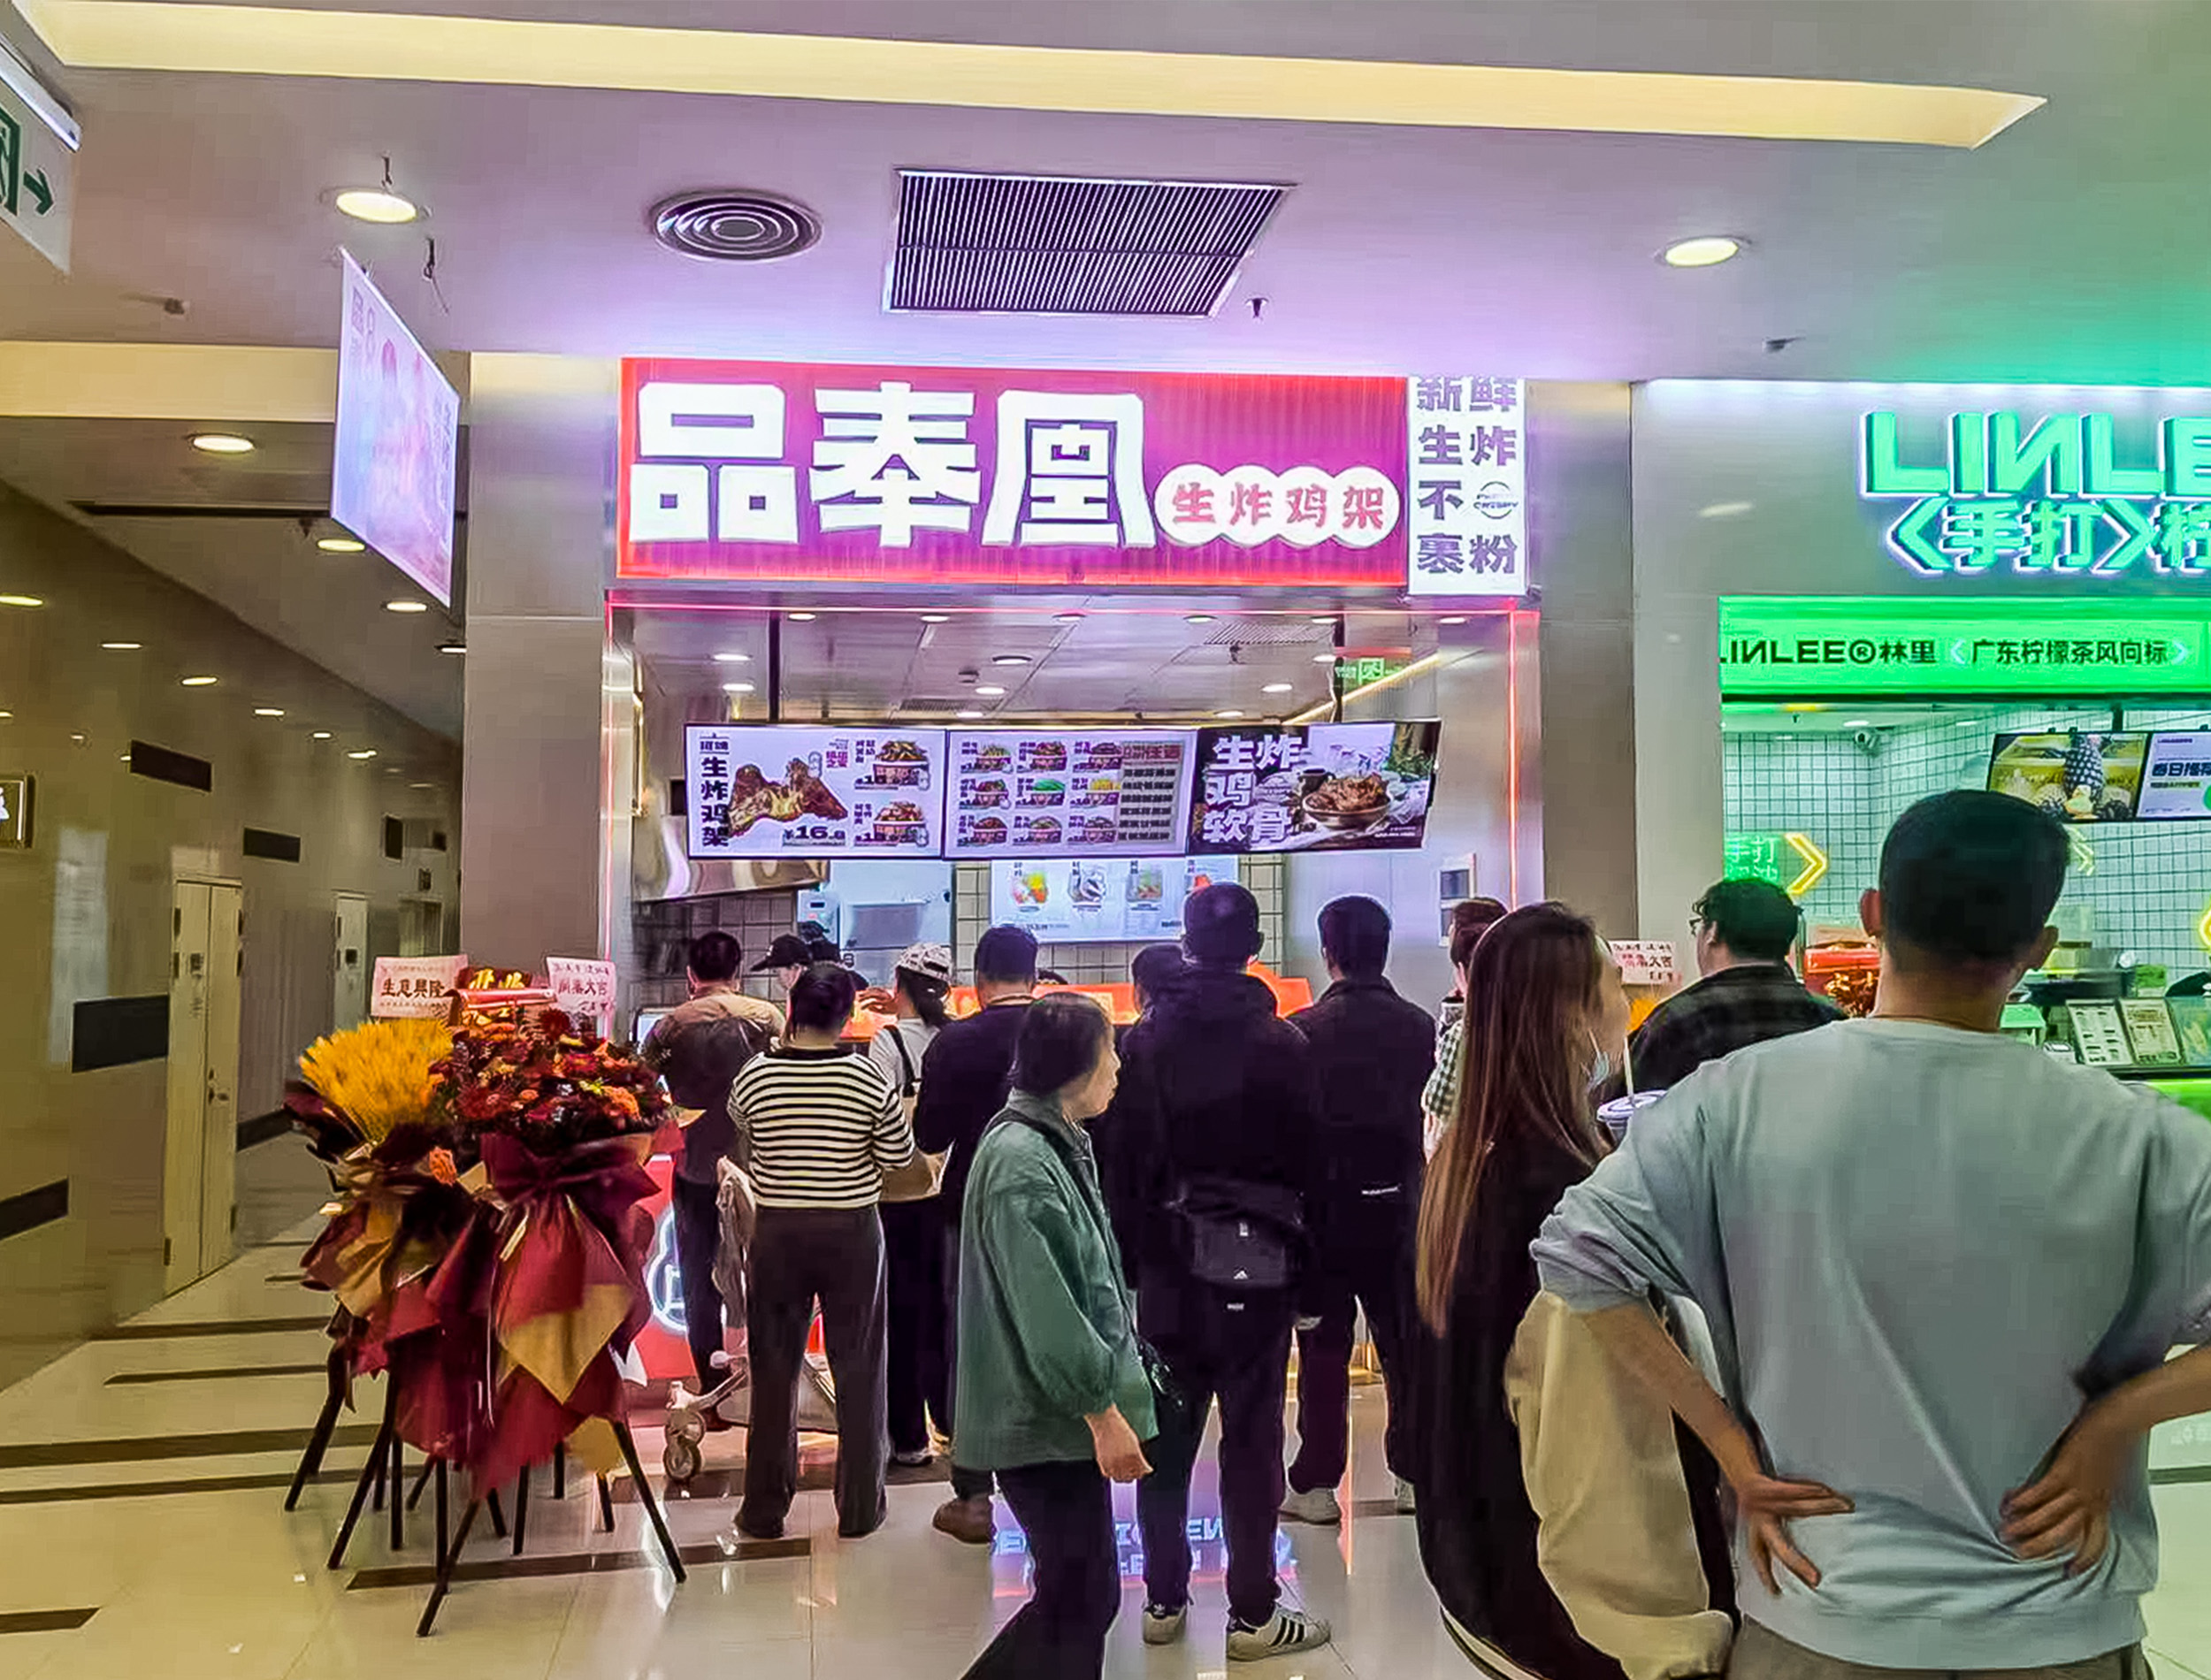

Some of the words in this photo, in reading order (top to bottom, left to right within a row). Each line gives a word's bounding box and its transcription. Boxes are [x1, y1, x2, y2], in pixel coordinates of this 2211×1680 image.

[629, 381, 1157, 548] 品奉凰
[1418, 424, 1517, 466] 生炸
[1172, 482, 1385, 531] 生炸鸡架
[1417, 480, 1465, 521] 不
[1417, 532, 1519, 575] 裹粉
[1213, 734, 1304, 771] 生炸
[700, 756, 731, 847] 生炸鸡架
[1205, 772, 1254, 806] 鸡
[1202, 806, 1293, 844] 软骨
